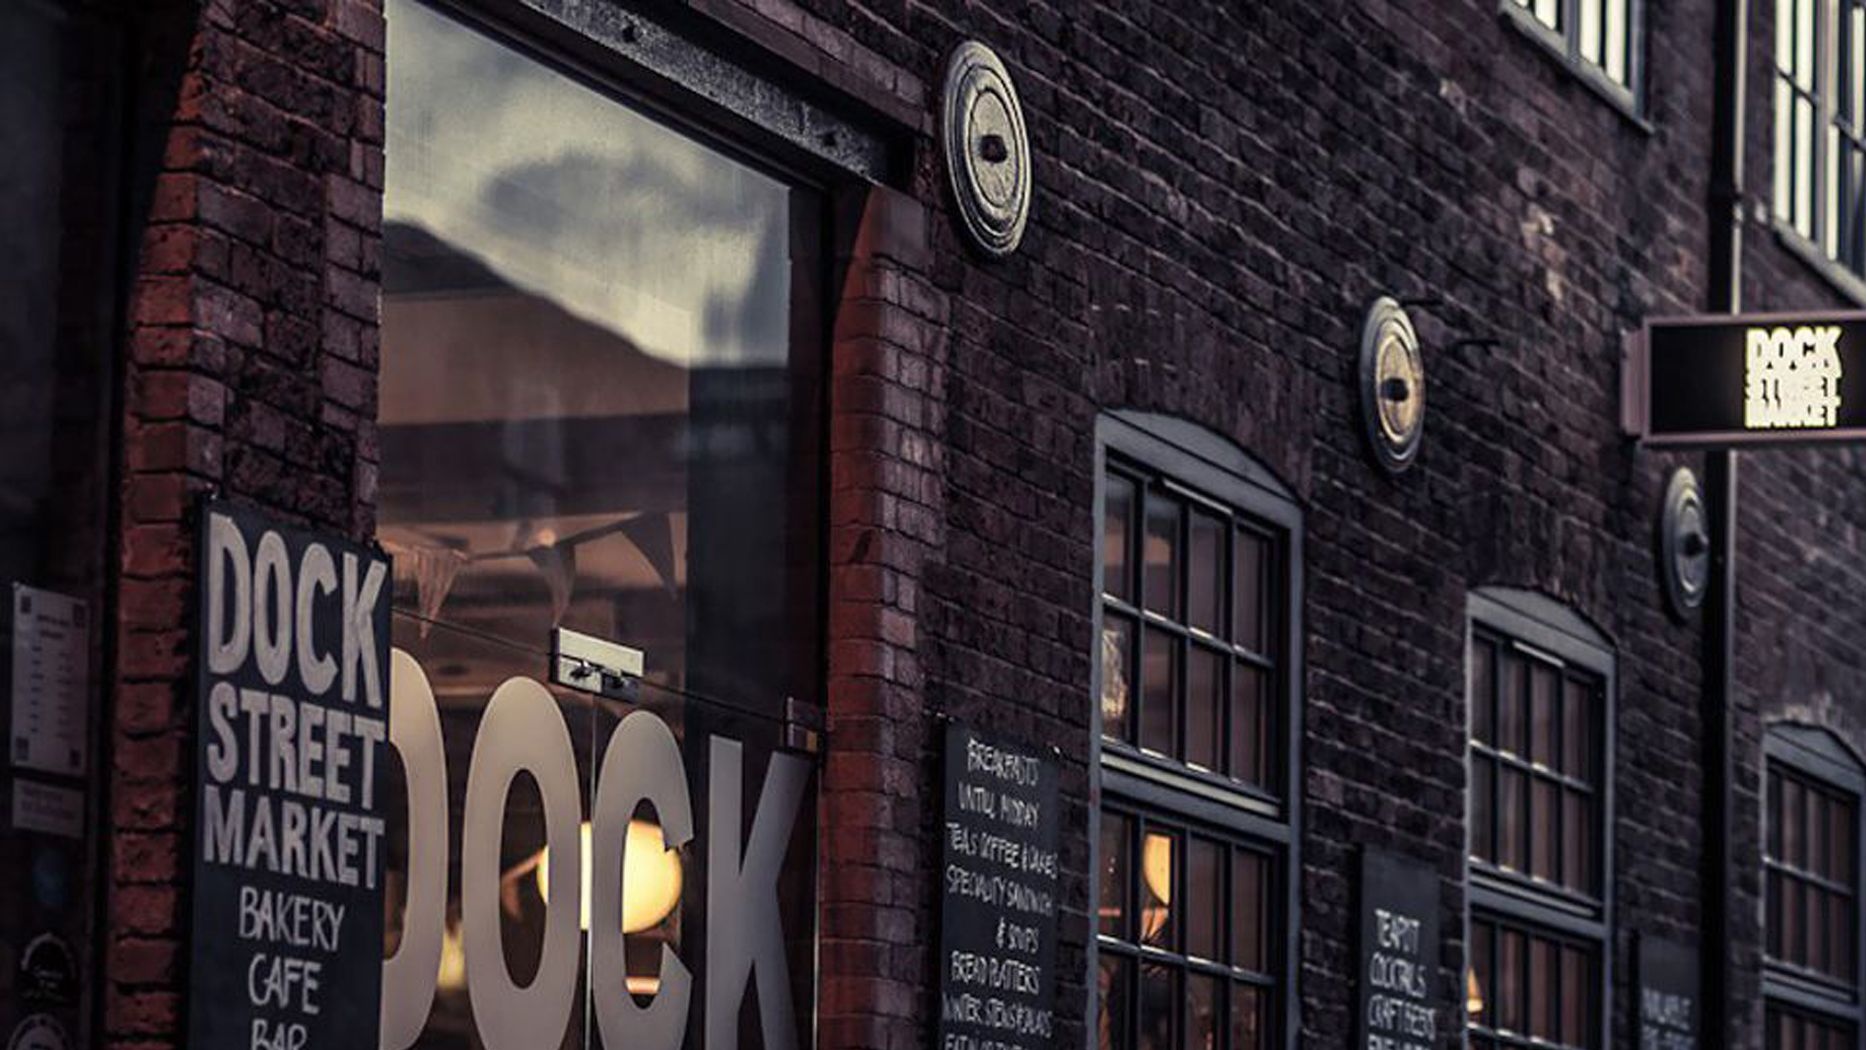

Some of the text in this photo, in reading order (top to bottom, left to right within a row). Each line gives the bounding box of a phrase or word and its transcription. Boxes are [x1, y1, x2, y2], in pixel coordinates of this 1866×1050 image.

[1746, 326, 1842, 376] DOCK
[207, 511, 388, 709] DOCK
[206, 681, 386, 811] STREET
[202, 784, 386, 890] MARKET
[238, 885, 346, 952] BAKERY
[249, 953, 322, 1015] CAFE
